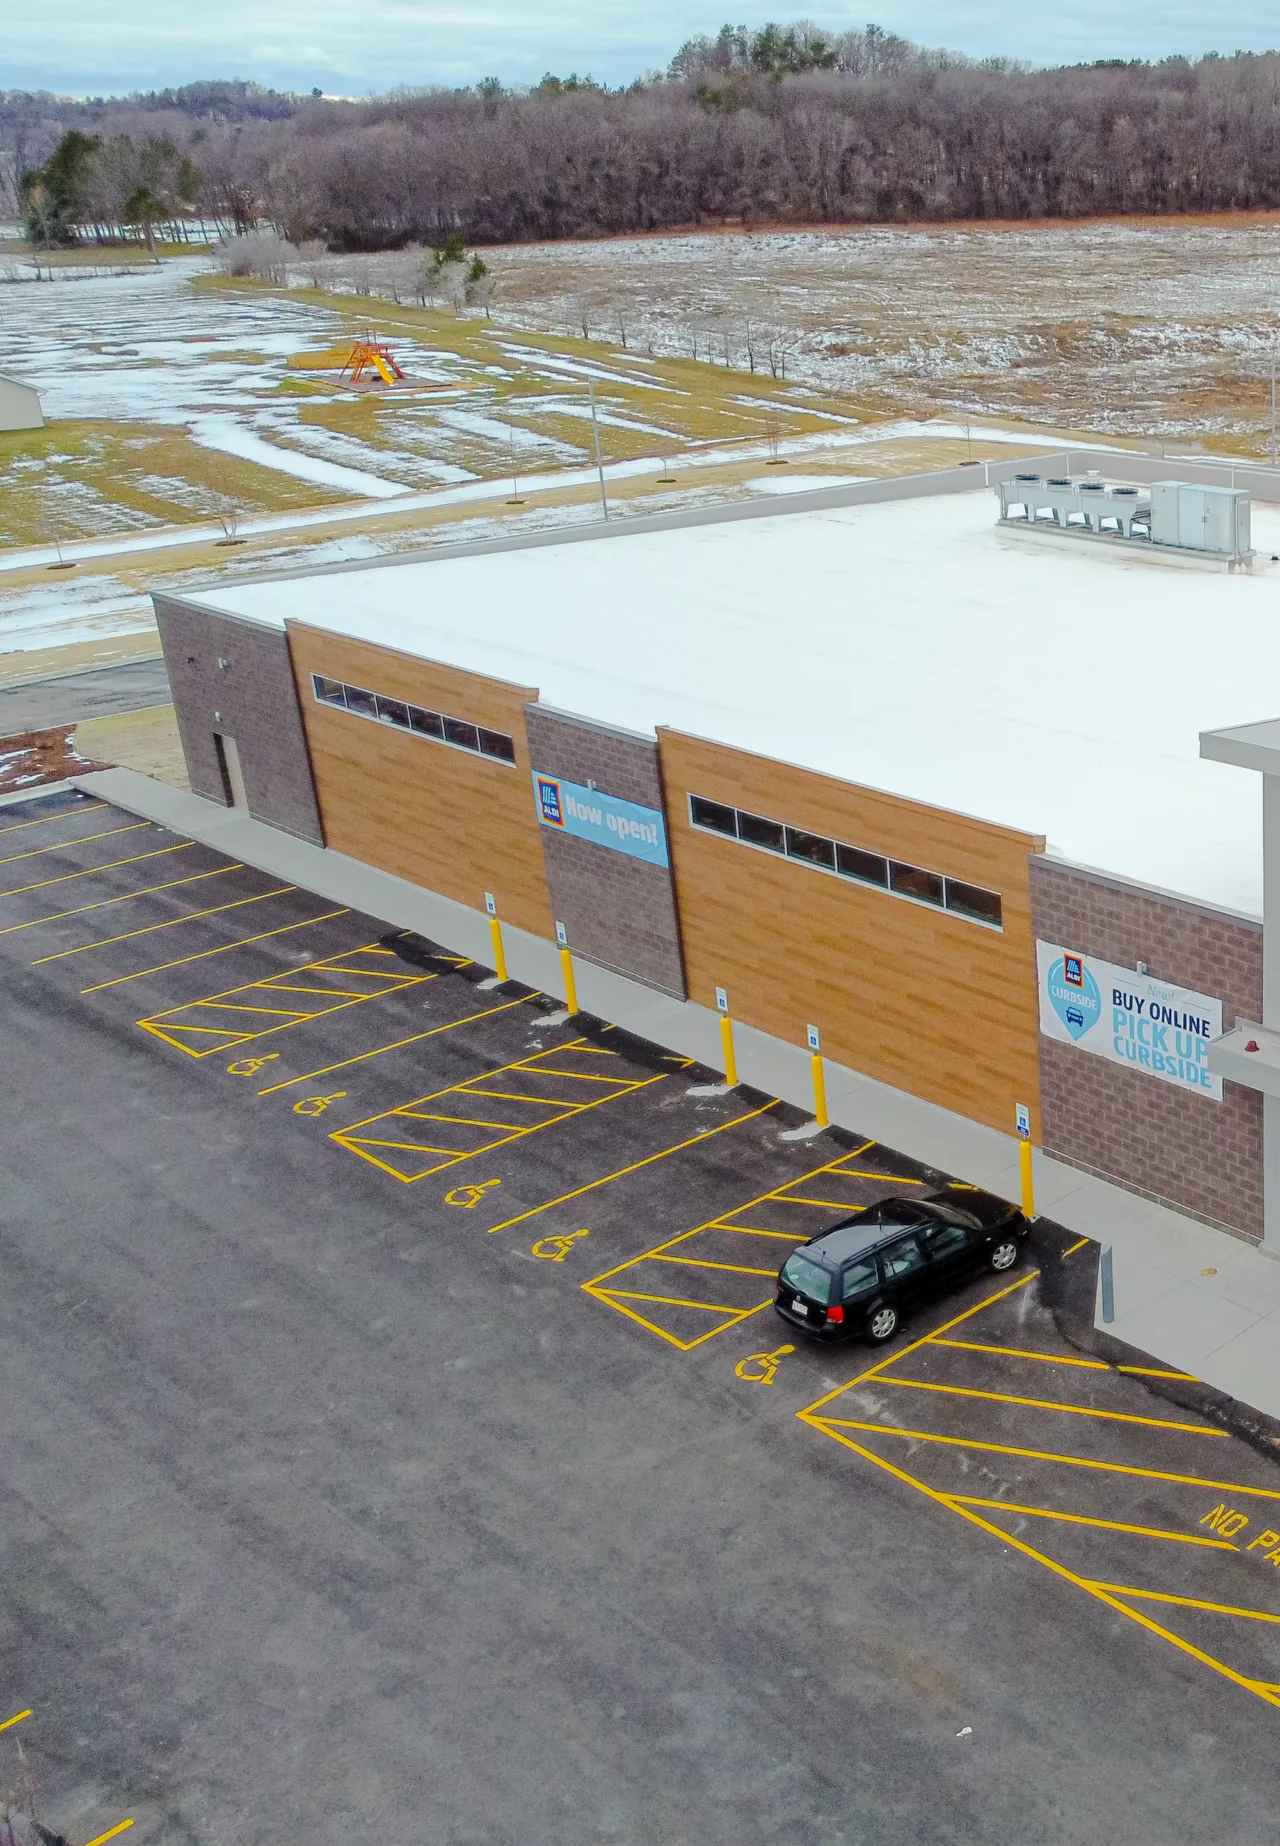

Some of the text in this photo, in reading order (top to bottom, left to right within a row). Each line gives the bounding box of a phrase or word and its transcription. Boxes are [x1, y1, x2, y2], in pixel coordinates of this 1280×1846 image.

[544, 806, 560, 818] ALDI
[566, 795, 657, 844] Now open!
[1067, 972, 1081, 982] ALDI
[1147, 984, 1175, 1003] New!
[1051, 985, 1097, 1011] CURBSIDE
[1112, 988, 1211, 1039] BUY ONLINE
[1112, 1008, 1209, 1064] PICK UP
[1113, 1035, 1212, 1089] CURBSIDE
[1199, 1503, 1250, 1538] NO
